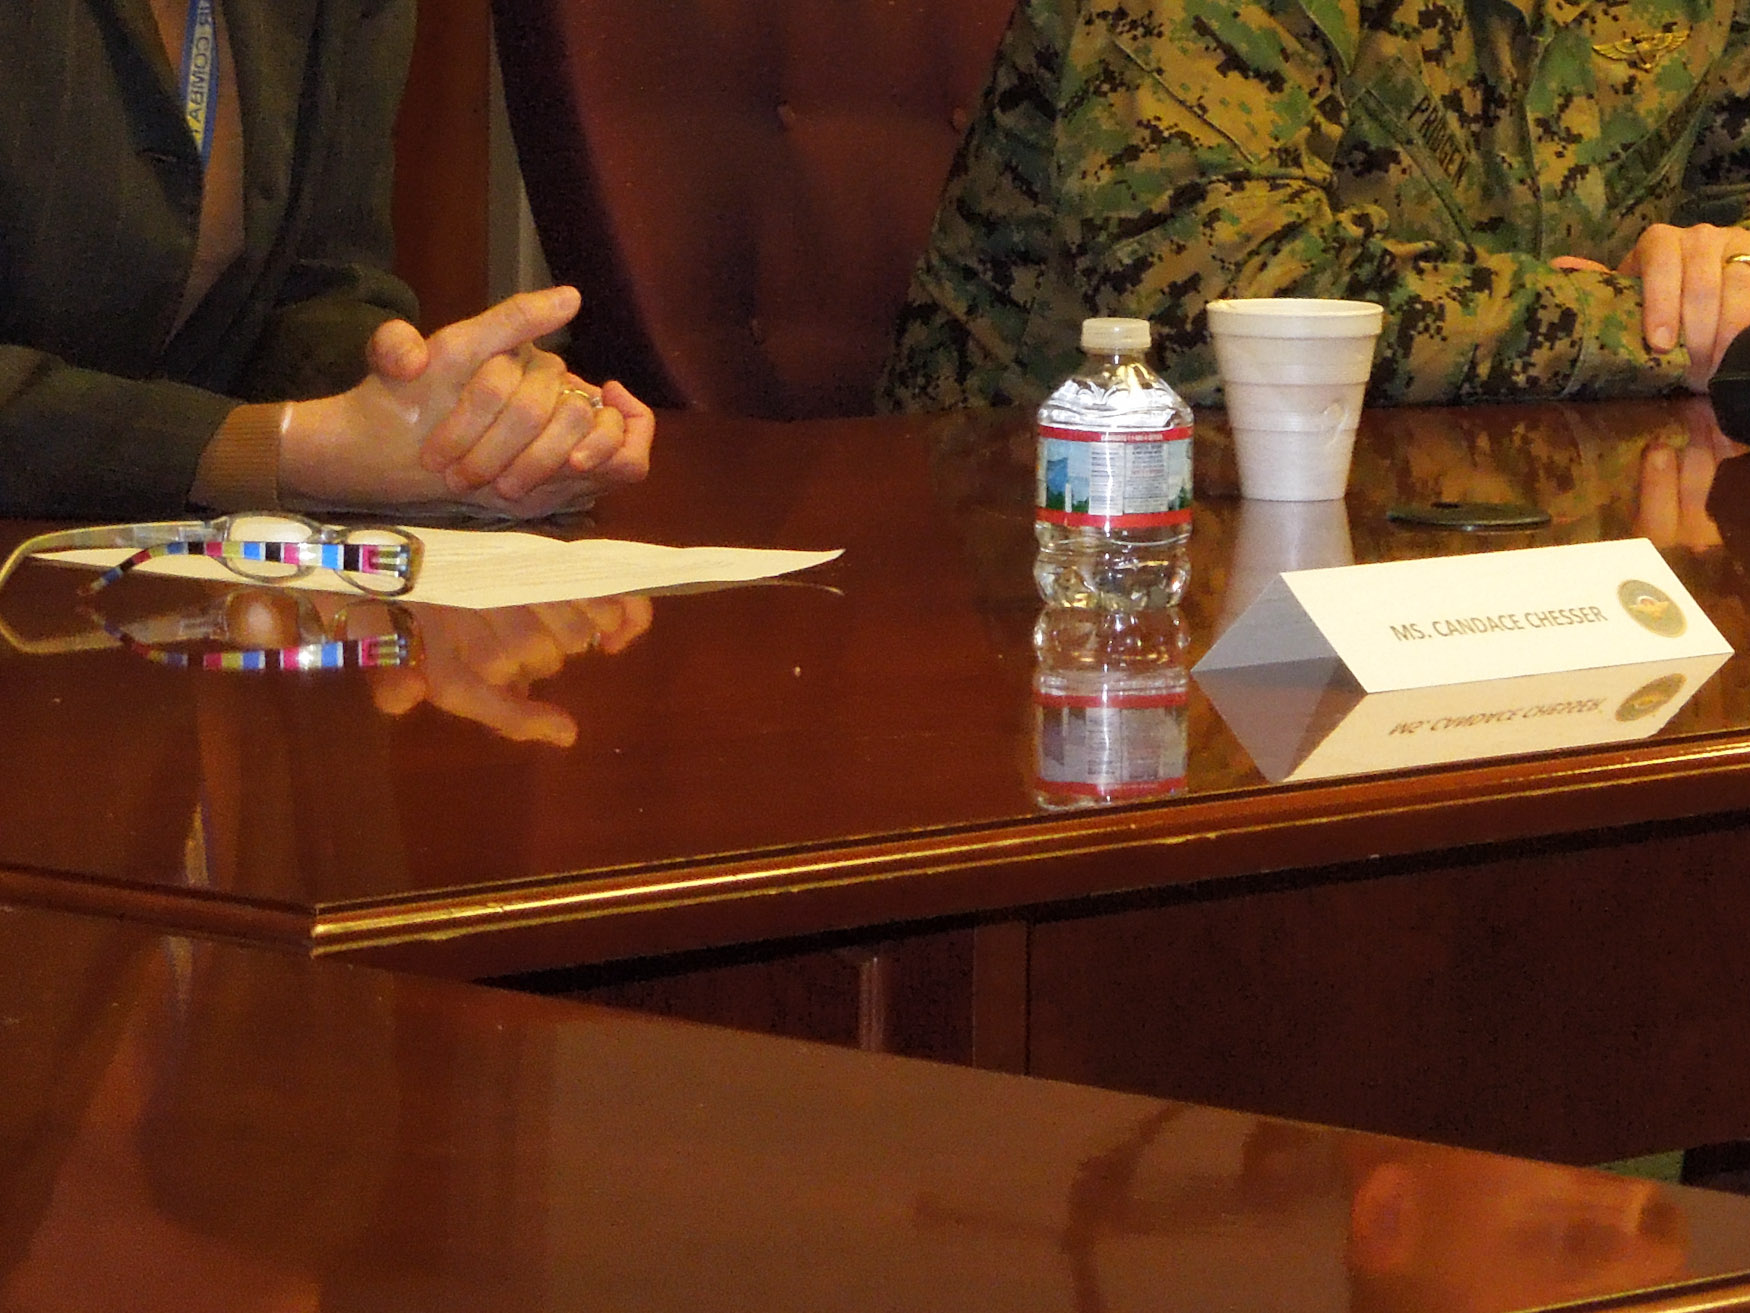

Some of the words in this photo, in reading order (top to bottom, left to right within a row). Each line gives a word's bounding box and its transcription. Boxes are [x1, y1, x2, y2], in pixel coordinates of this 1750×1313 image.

[1389, 623, 1432, 641] MS.
[1432, 613, 1525, 637] CANDACE
[1524, 605, 1609, 628] CHESSER
